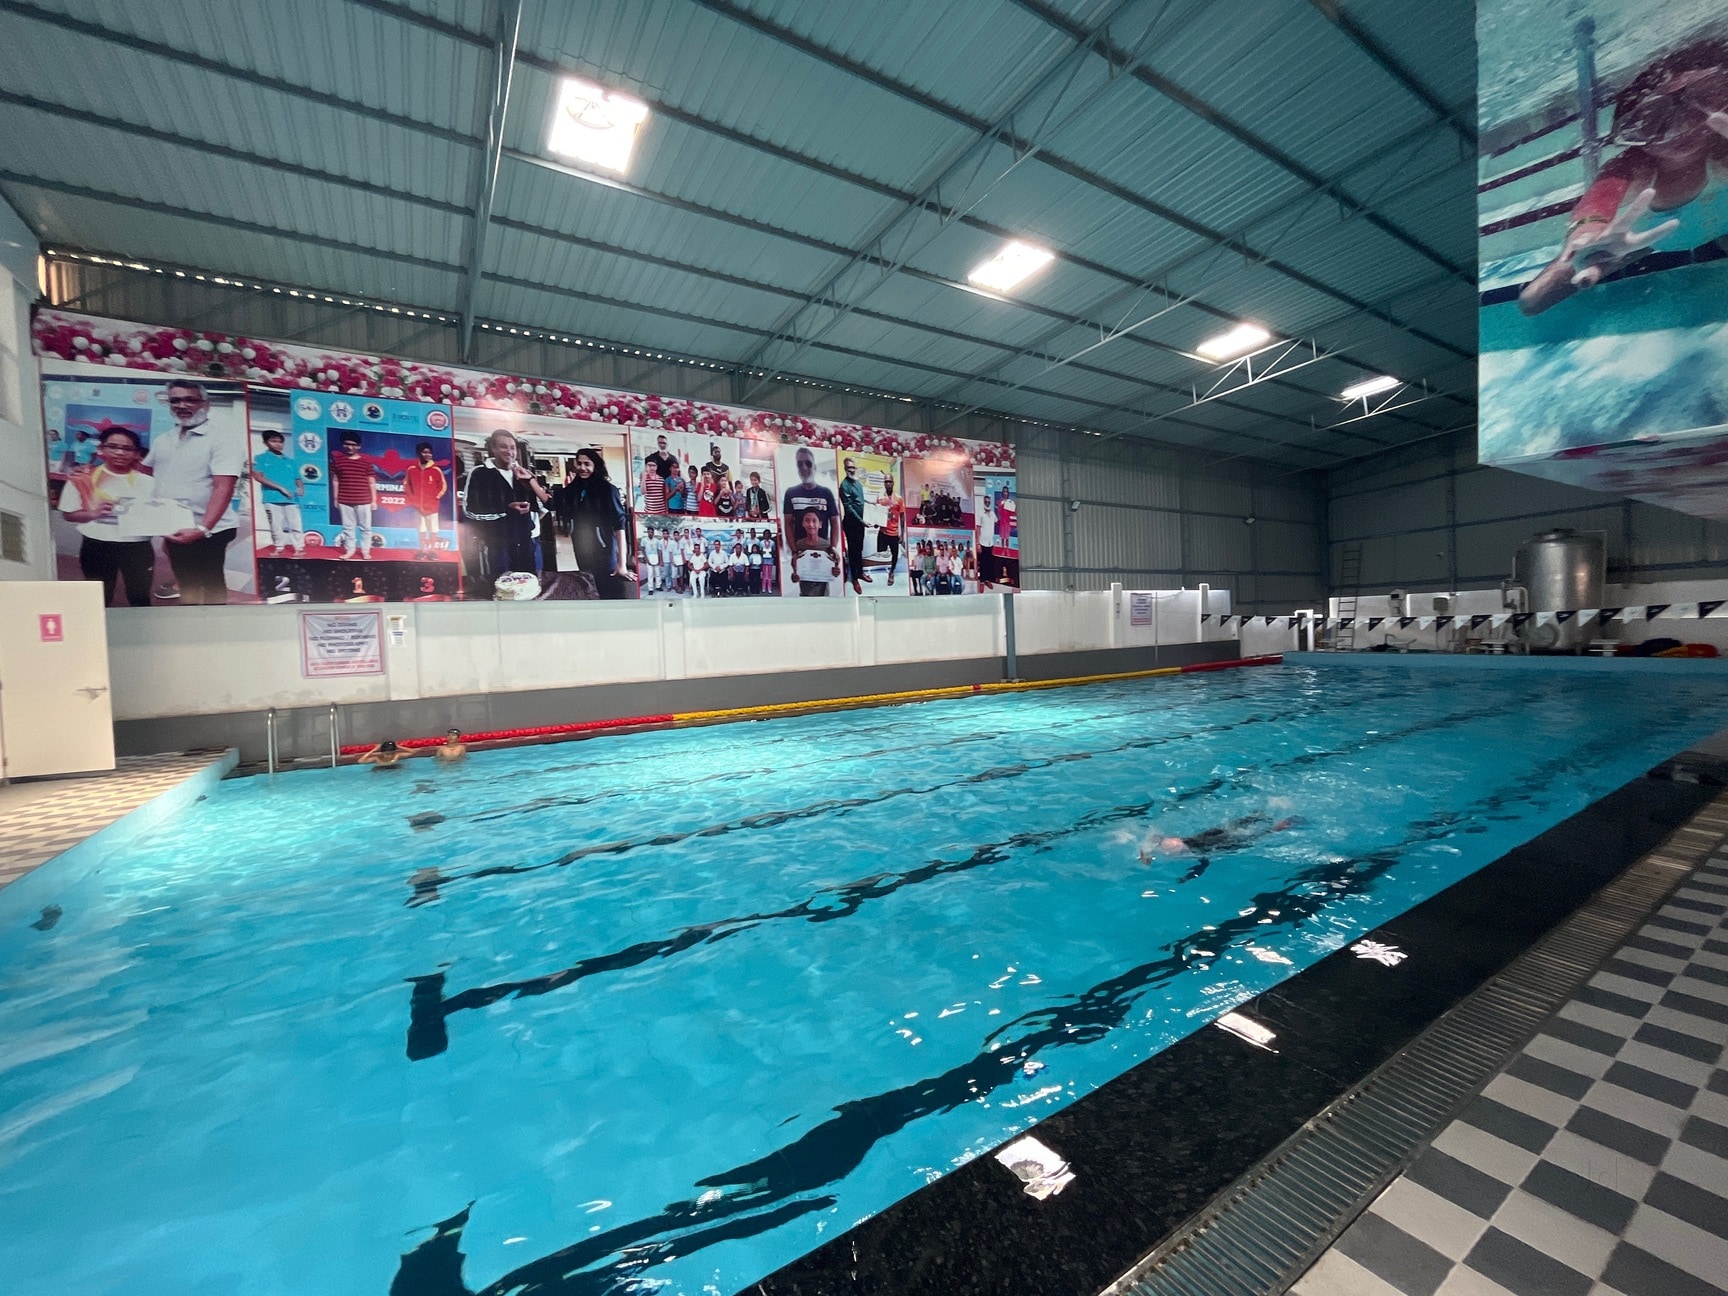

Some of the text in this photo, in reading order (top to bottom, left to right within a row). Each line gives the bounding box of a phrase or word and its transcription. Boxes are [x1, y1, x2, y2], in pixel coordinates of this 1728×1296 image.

[380, 496, 406, 505] 2022
[274, 575, 291, 592] 2
[351, 576, 366, 594] 1
[419, 576, 435, 593] 3
